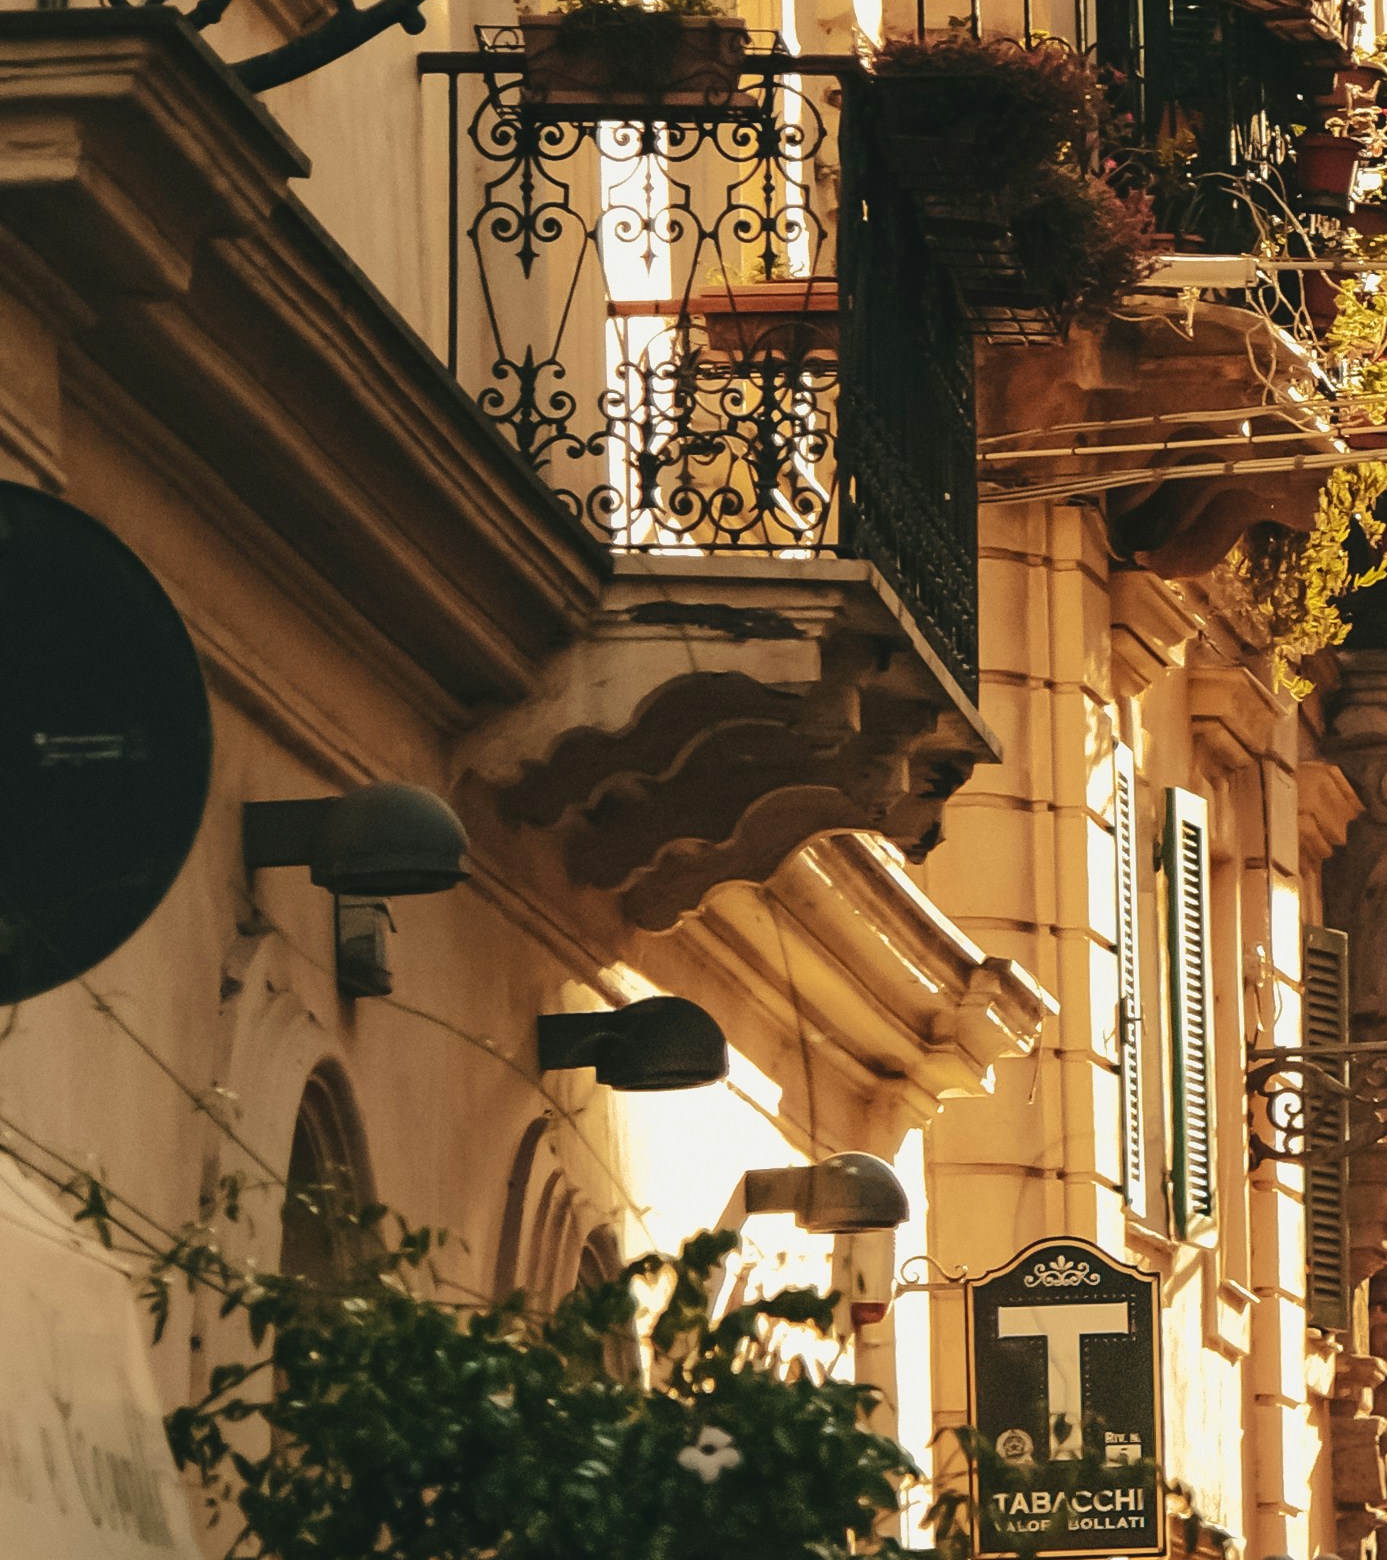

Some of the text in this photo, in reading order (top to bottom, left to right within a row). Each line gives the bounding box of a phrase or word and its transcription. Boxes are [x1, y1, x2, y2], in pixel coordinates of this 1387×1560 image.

[998, 1302, 1129, 1460] T
[992, 1489, 1145, 1515] TABACCHI
[1067, 1517, 1145, 1531] BOLLATI
